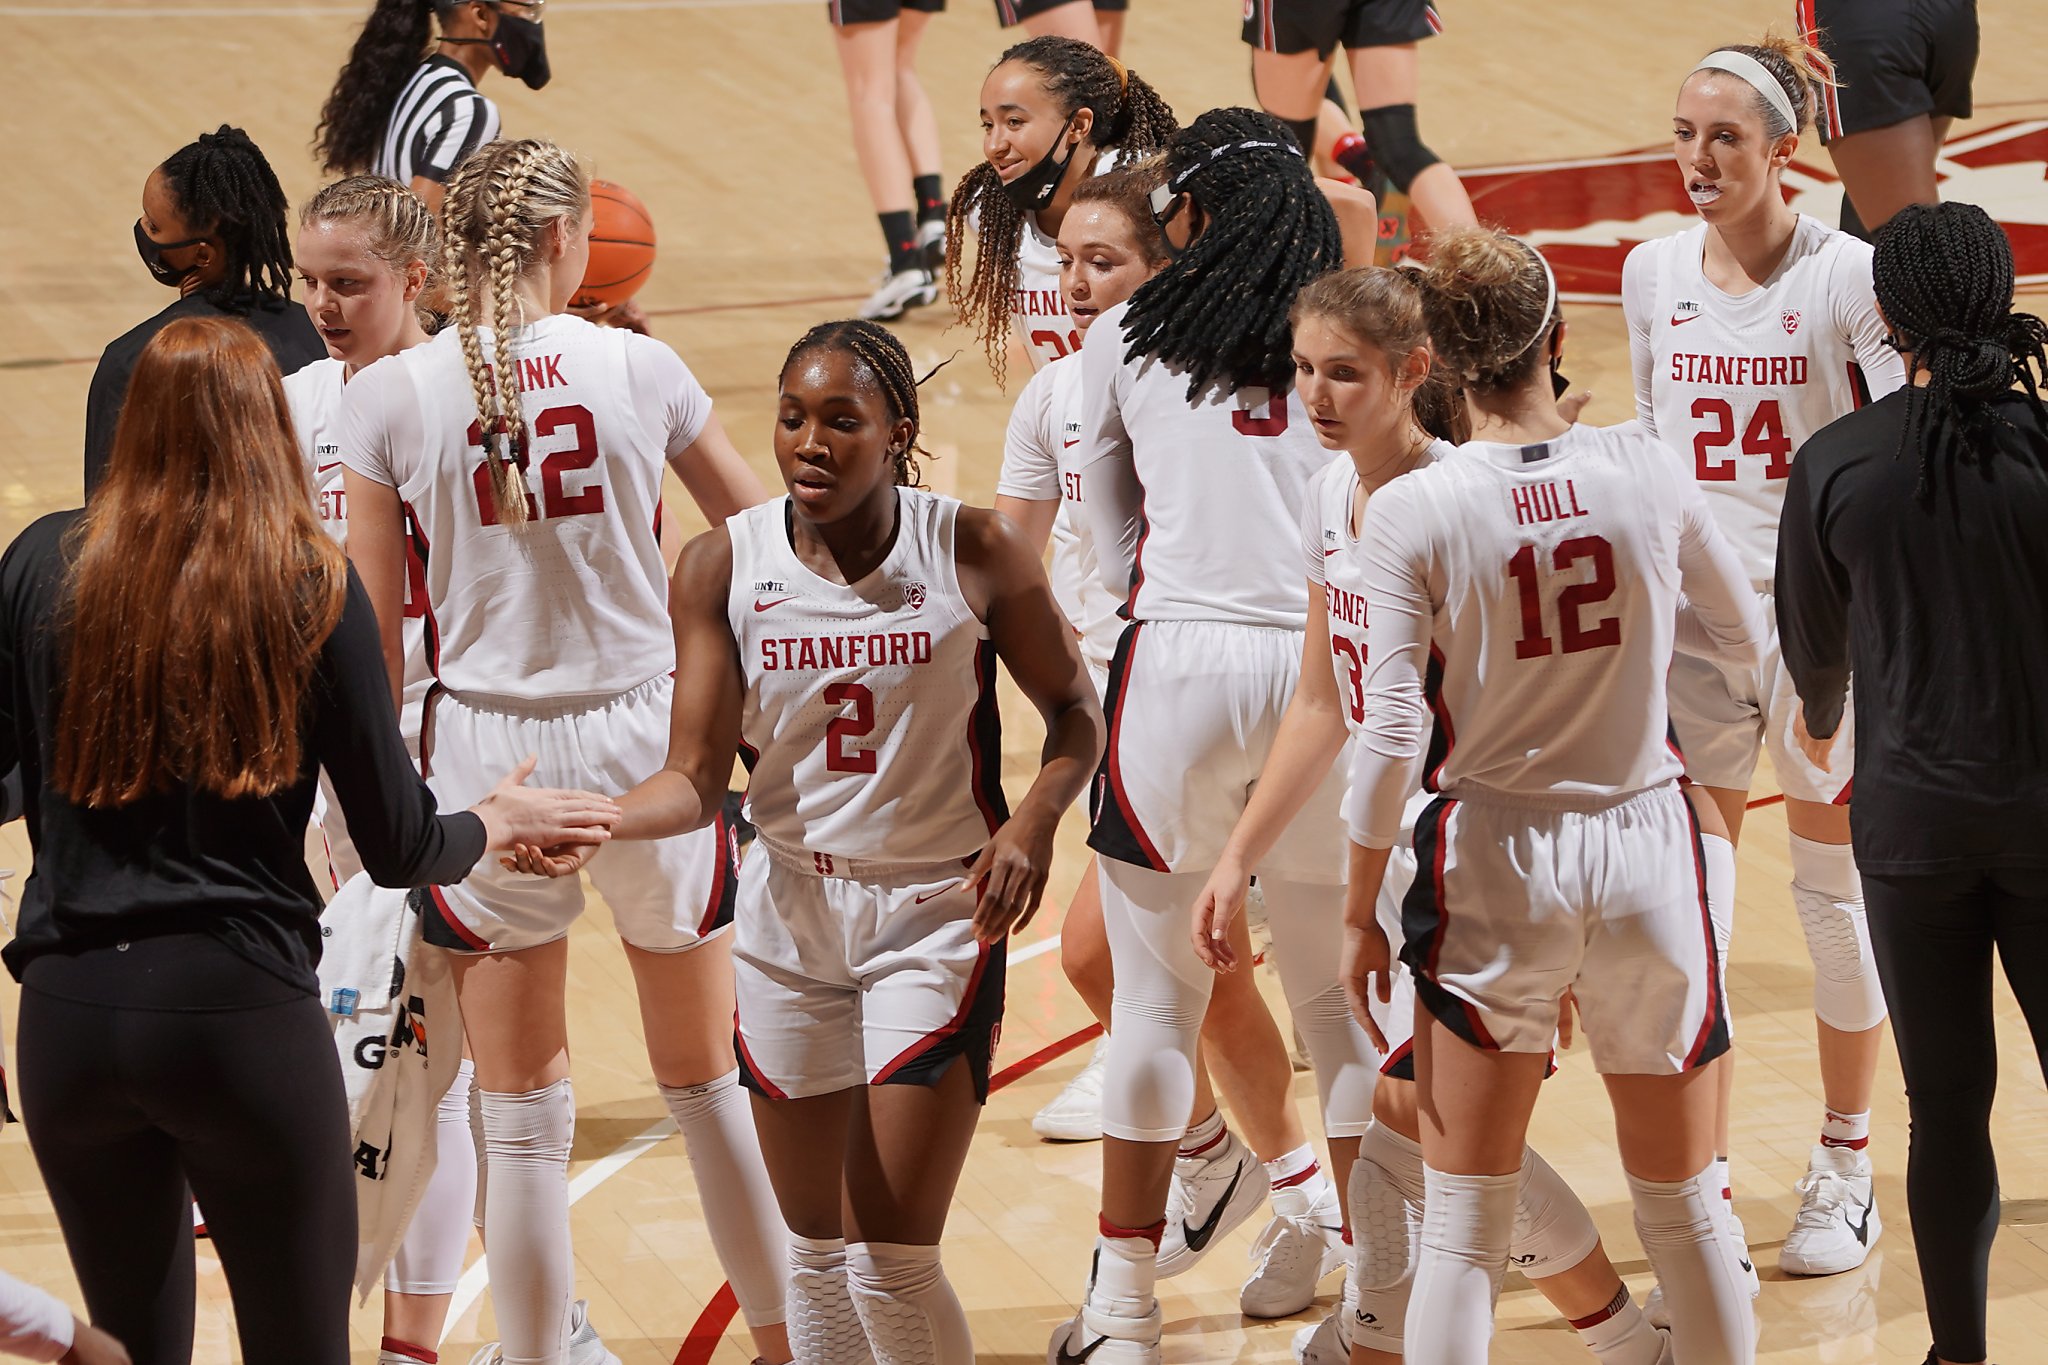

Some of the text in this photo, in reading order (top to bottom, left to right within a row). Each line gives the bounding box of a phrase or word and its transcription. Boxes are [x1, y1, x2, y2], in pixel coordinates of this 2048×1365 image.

[1785, 320, 1796, 331] 12
[482, 354, 569, 397] INK
[1672, 353, 1808, 385] STANFORD
[1691, 398, 1792, 481] 24
[466, 404, 605, 526] 22
[1512, 480, 1589, 525] HULL
[910, 593, 922, 605] 12
[1509, 535, 1621, 659] 12
[761, 631, 932, 671] STANFORD
[823, 683, 877, 774] 2
